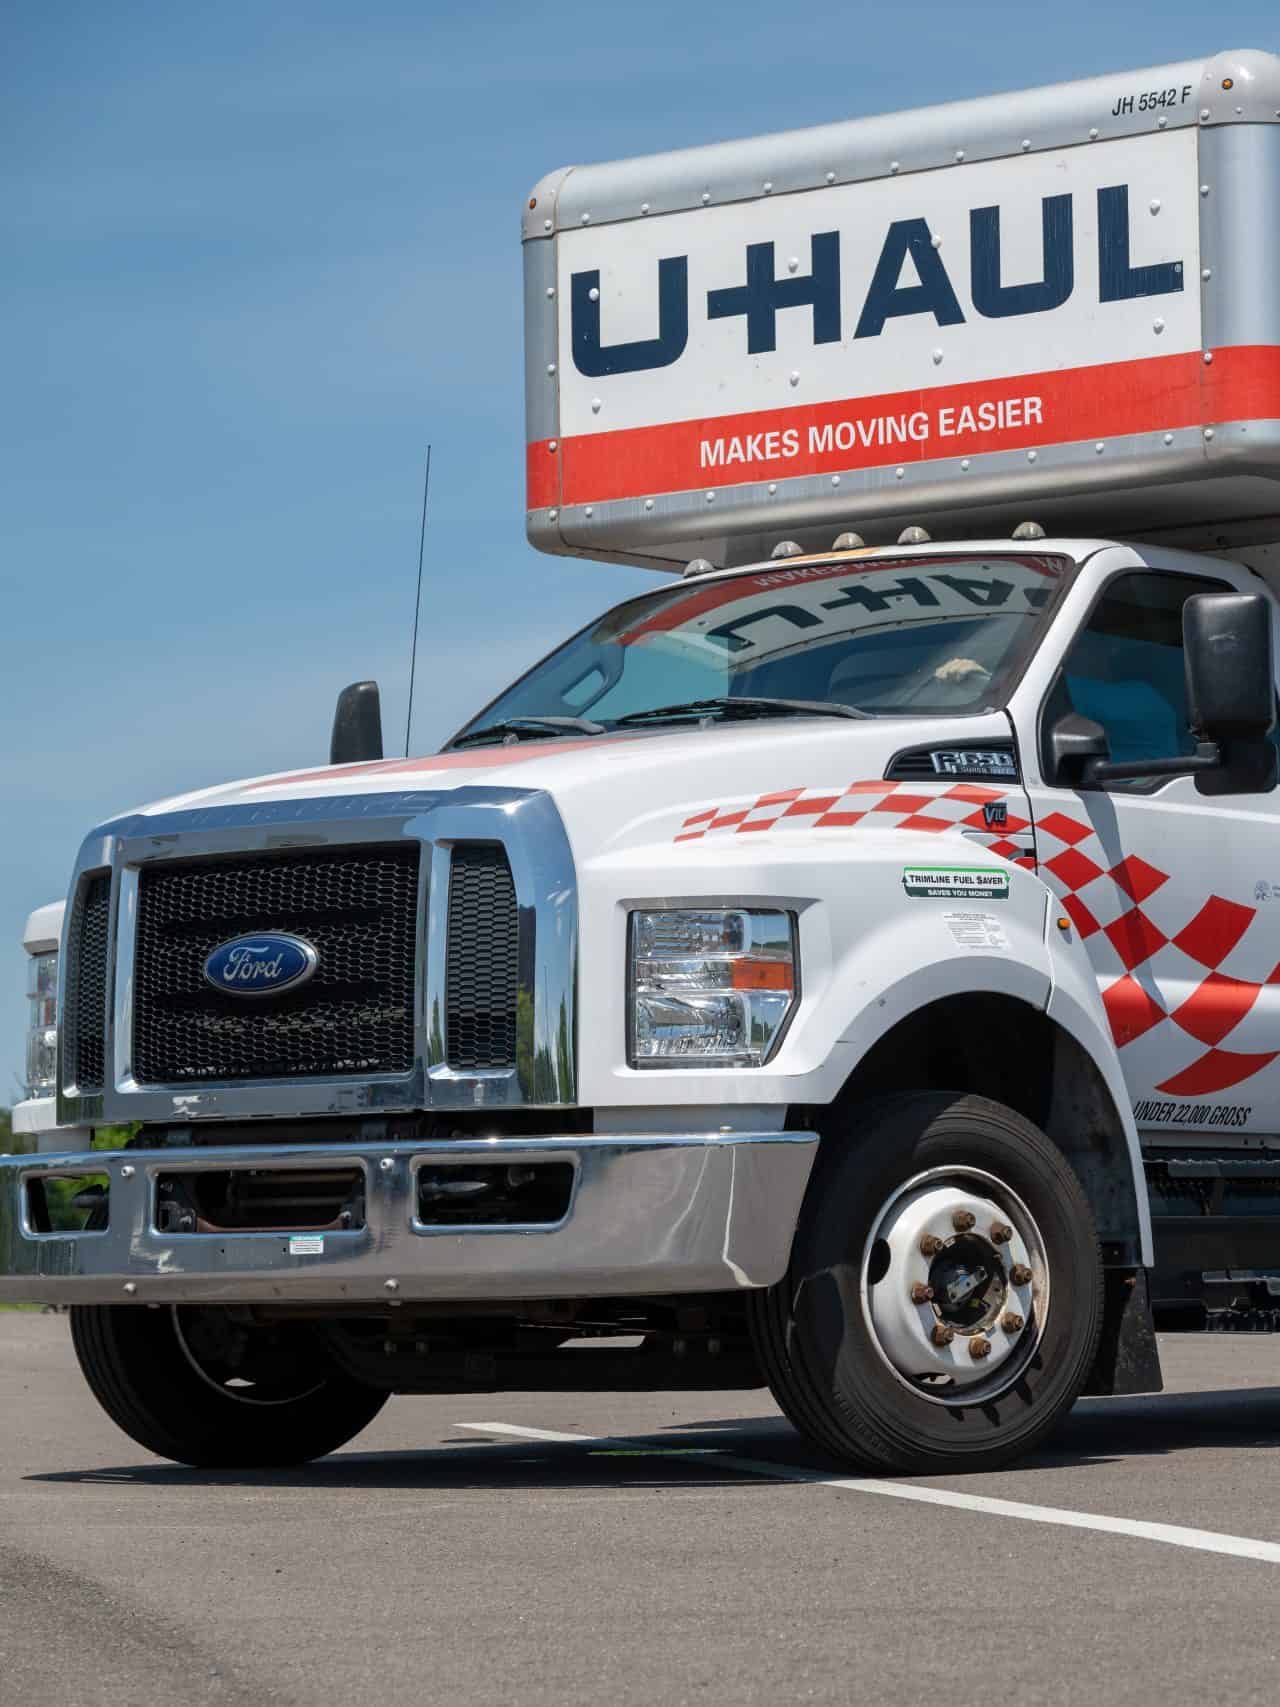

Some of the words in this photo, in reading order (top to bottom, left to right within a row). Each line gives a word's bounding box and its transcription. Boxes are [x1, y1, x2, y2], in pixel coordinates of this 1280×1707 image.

[1112, 95, 1134, 116] JH
[1138, 88, 1177, 111] 5542
[1181, 85, 1192, 104] F
[700, 429, 800, 468] MAKES
[808, 411, 929, 454] MOVING
[938, 396, 1044, 437] EASIER
[908, 874, 951, 884] TRIMLINE
[953, 875, 974, 885] FUEL
[976, 876, 1003, 885] SAVER
[223, 946, 284, 980] Ford
[1133, 1100, 1176, 1122] UNDER
[1172, 1103, 1211, 1126] 22,000
[1209, 1104, 1252, 1127] GROSS
